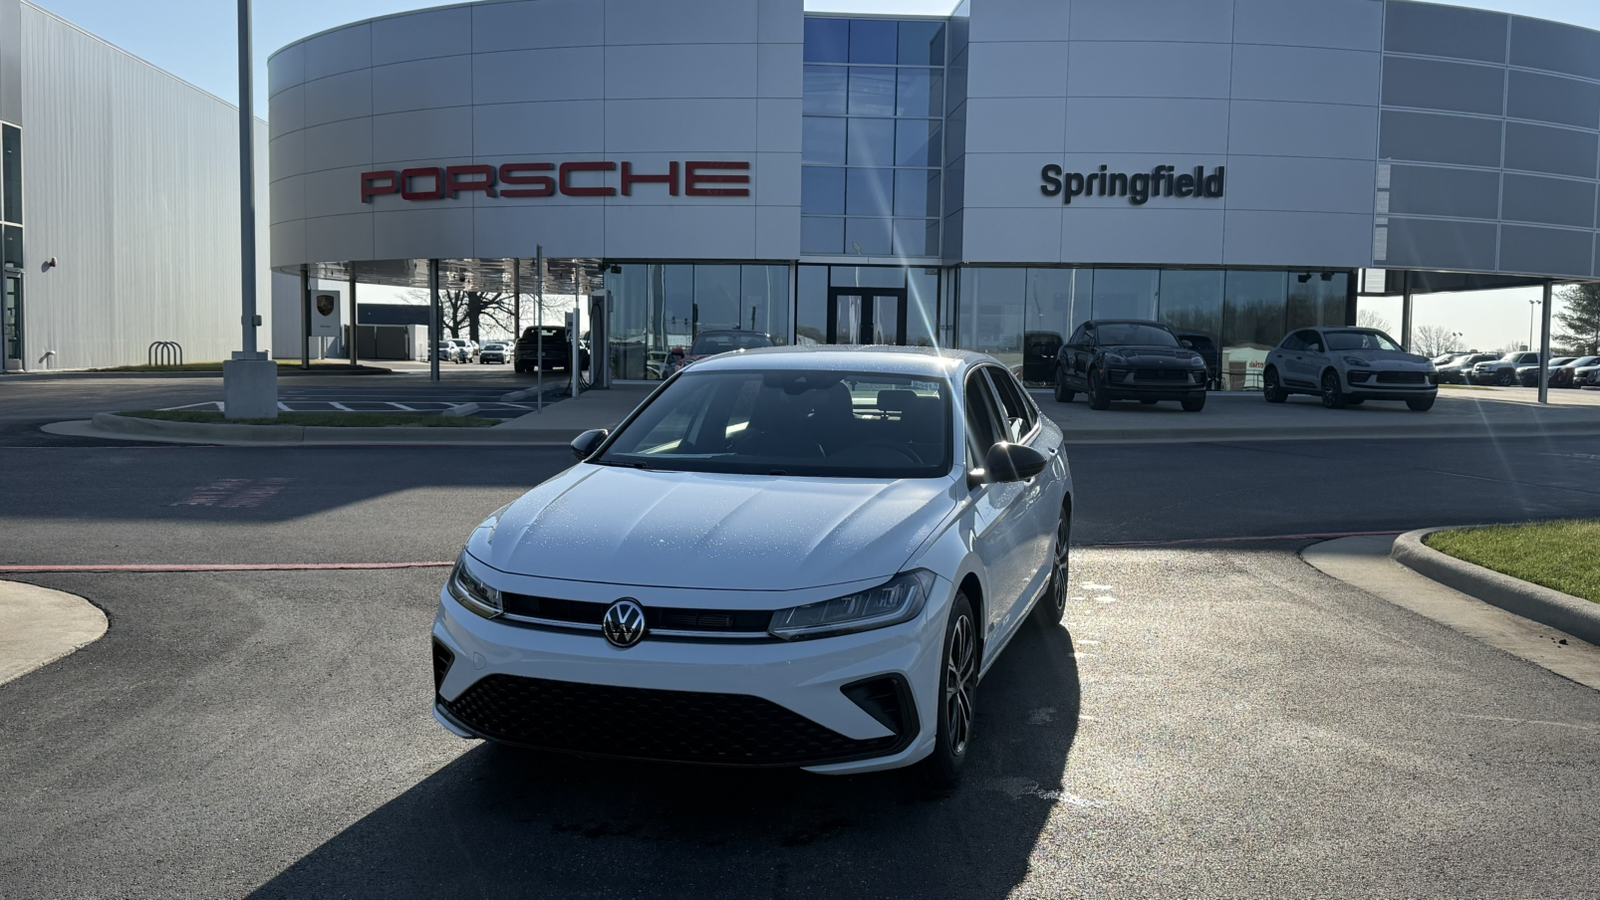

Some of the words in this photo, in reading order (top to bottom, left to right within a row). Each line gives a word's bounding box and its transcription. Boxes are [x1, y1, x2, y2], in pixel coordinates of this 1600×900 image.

[361, 161, 750, 203] PORSCHE
[1040, 163, 1225, 205] Springfield
[604, 602, 644, 645] VW
